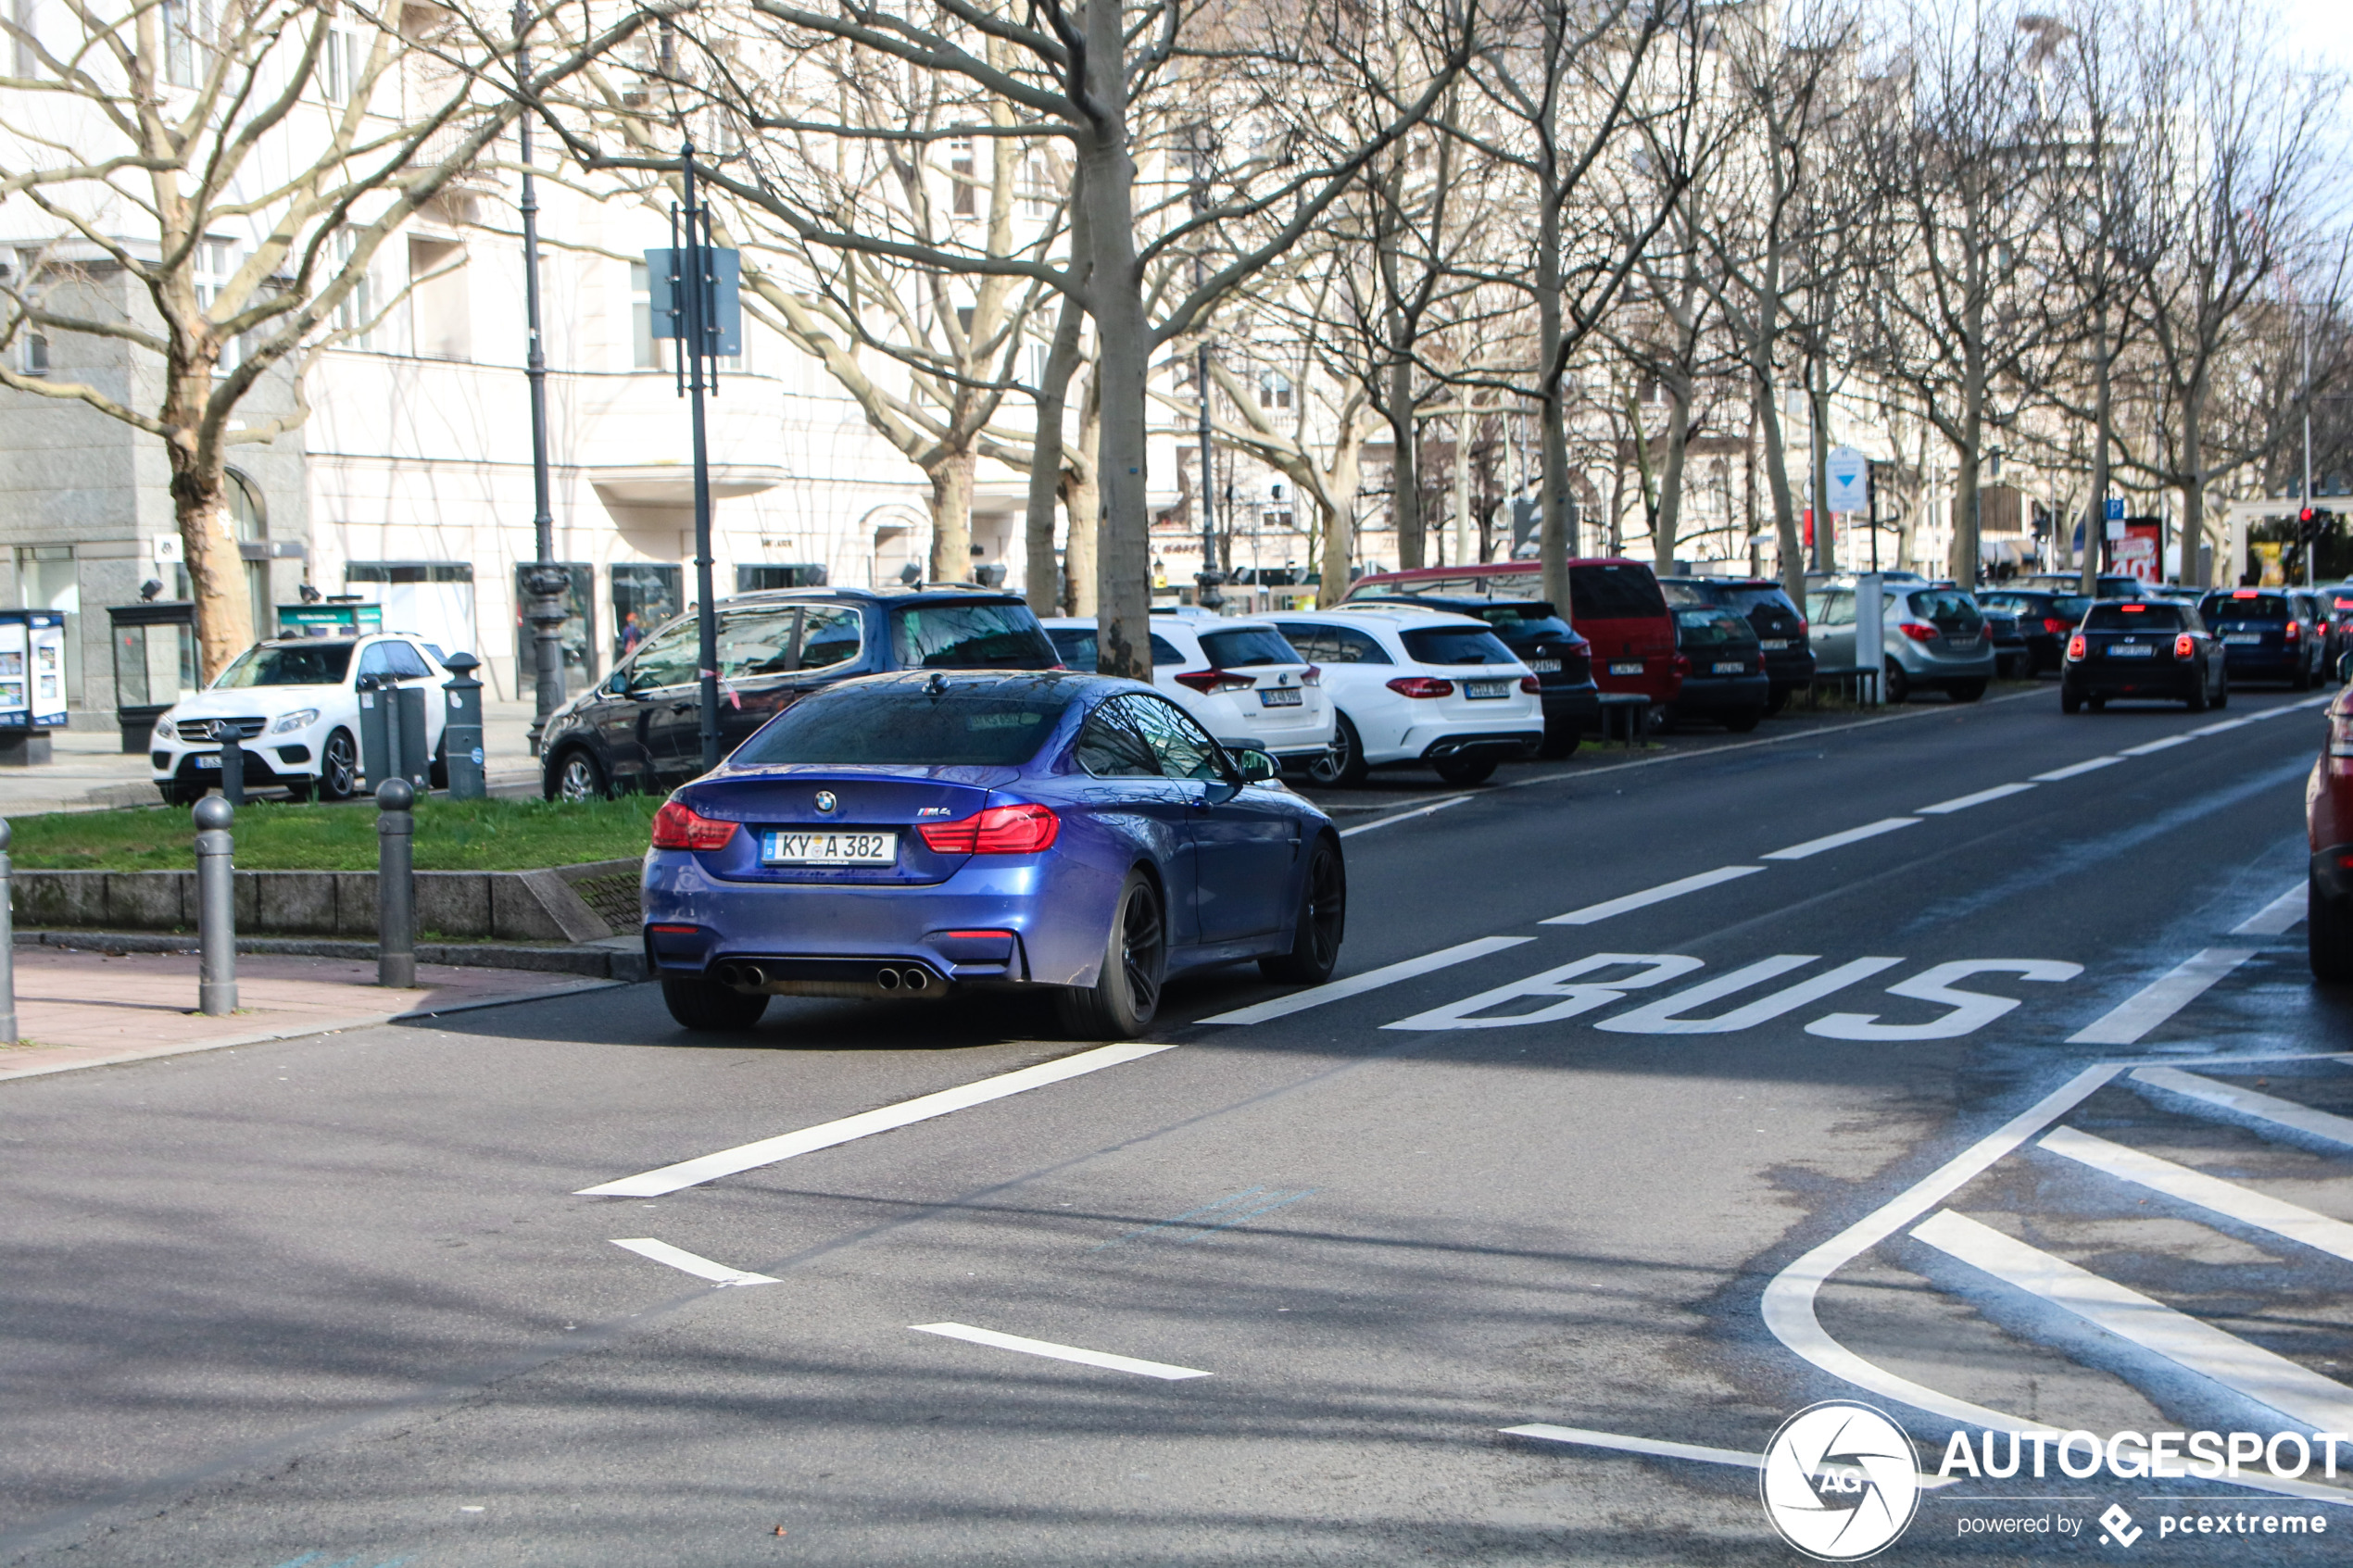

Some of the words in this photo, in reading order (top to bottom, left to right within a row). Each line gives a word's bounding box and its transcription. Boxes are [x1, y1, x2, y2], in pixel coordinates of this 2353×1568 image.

[2110, 501, 2120, 518] P
[783, 834, 811, 857] KY
[824, 835, 837, 857] A
[844, 835, 884, 858] 382
[1378, 952, 2085, 1041] BUS
